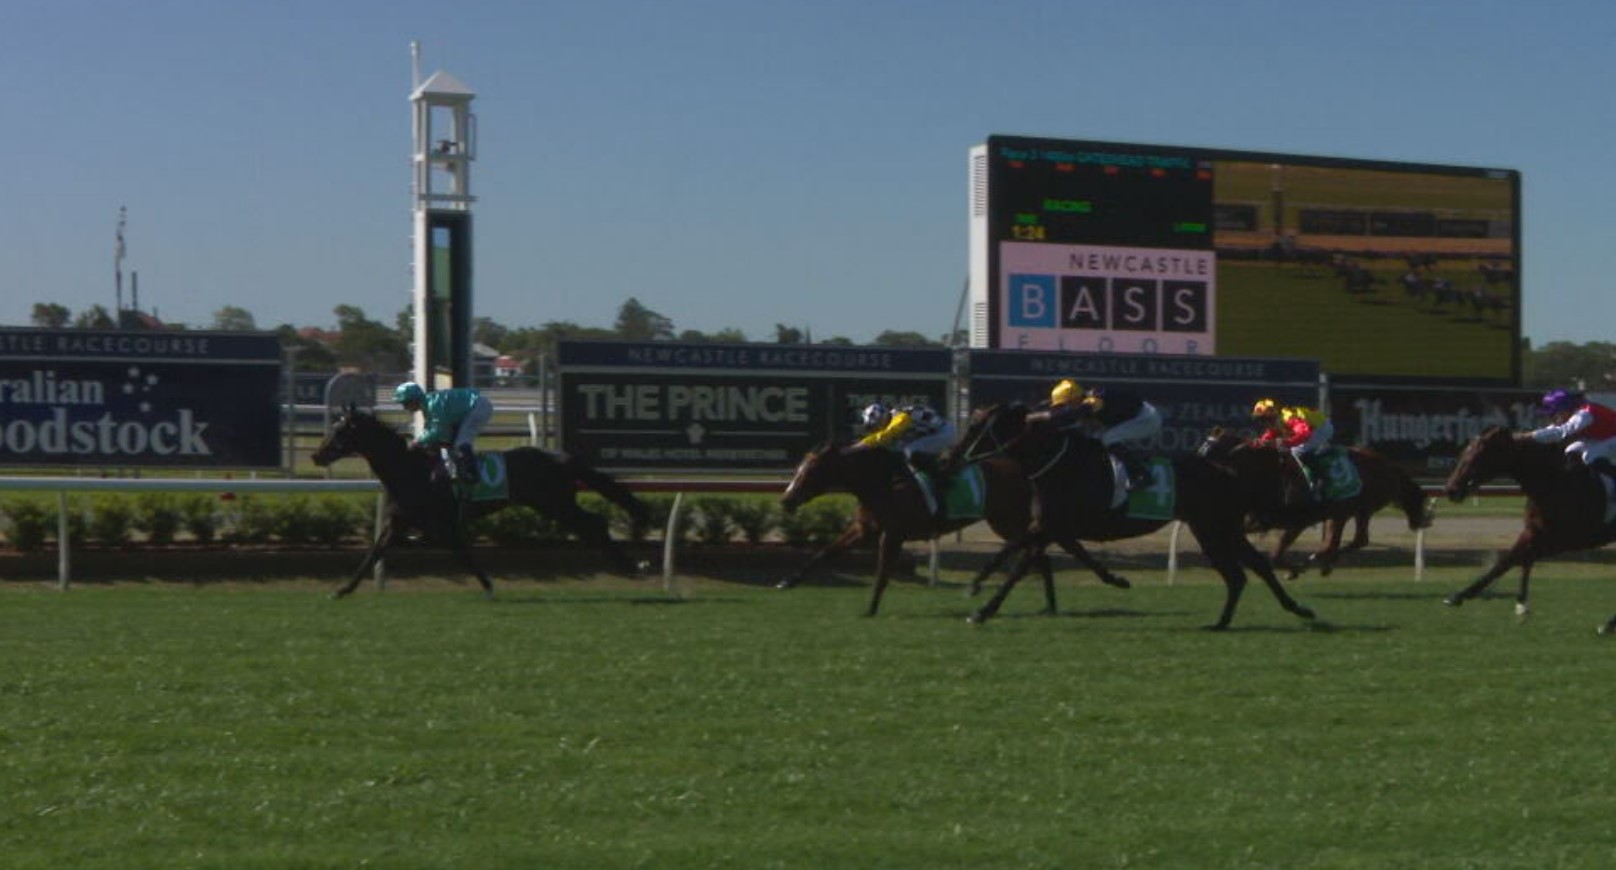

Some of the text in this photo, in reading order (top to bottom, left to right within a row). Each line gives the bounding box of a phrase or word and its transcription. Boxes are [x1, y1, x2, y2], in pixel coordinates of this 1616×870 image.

[1069, 253, 1208, 275] NEWCASTLE
[1022, 284, 1196, 325] BASS
[57, 336, 209, 354] RACECOURSE
[628, 348, 892, 369] NEWCASTLE RACECOURSE
[1030, 357, 1265, 378] NEWCASTLE RACECOURSE
[578, 384, 809, 421] THE PRINCE
[0, 407, 212, 455] odstock
